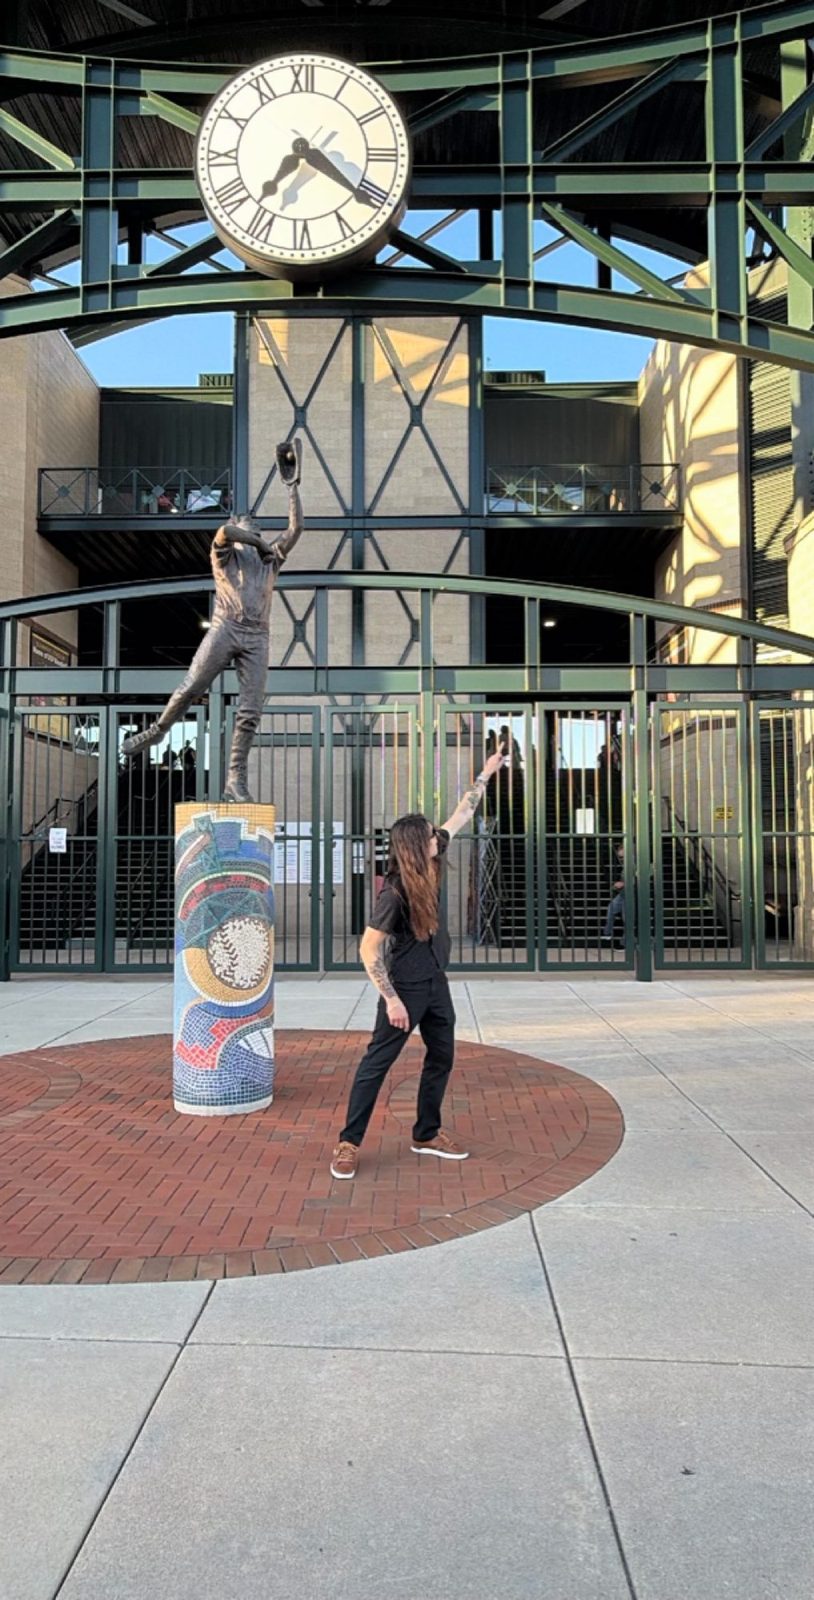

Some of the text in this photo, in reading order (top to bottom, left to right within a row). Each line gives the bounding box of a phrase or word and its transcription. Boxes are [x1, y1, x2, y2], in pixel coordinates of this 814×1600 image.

[248, 74, 278, 105] XI
[291, 65, 315, 92] XII
[334, 76, 350, 100] I
[219, 108, 248, 130] X
[357, 106, 386, 126] II
[208, 148, 238, 167] IX
[367, 147, 398, 161] III
[215, 177, 252, 216] VIII
[246, 206, 276, 243] VII
[293, 219, 312, 250] VI
[335, 211, 355, 239] V
